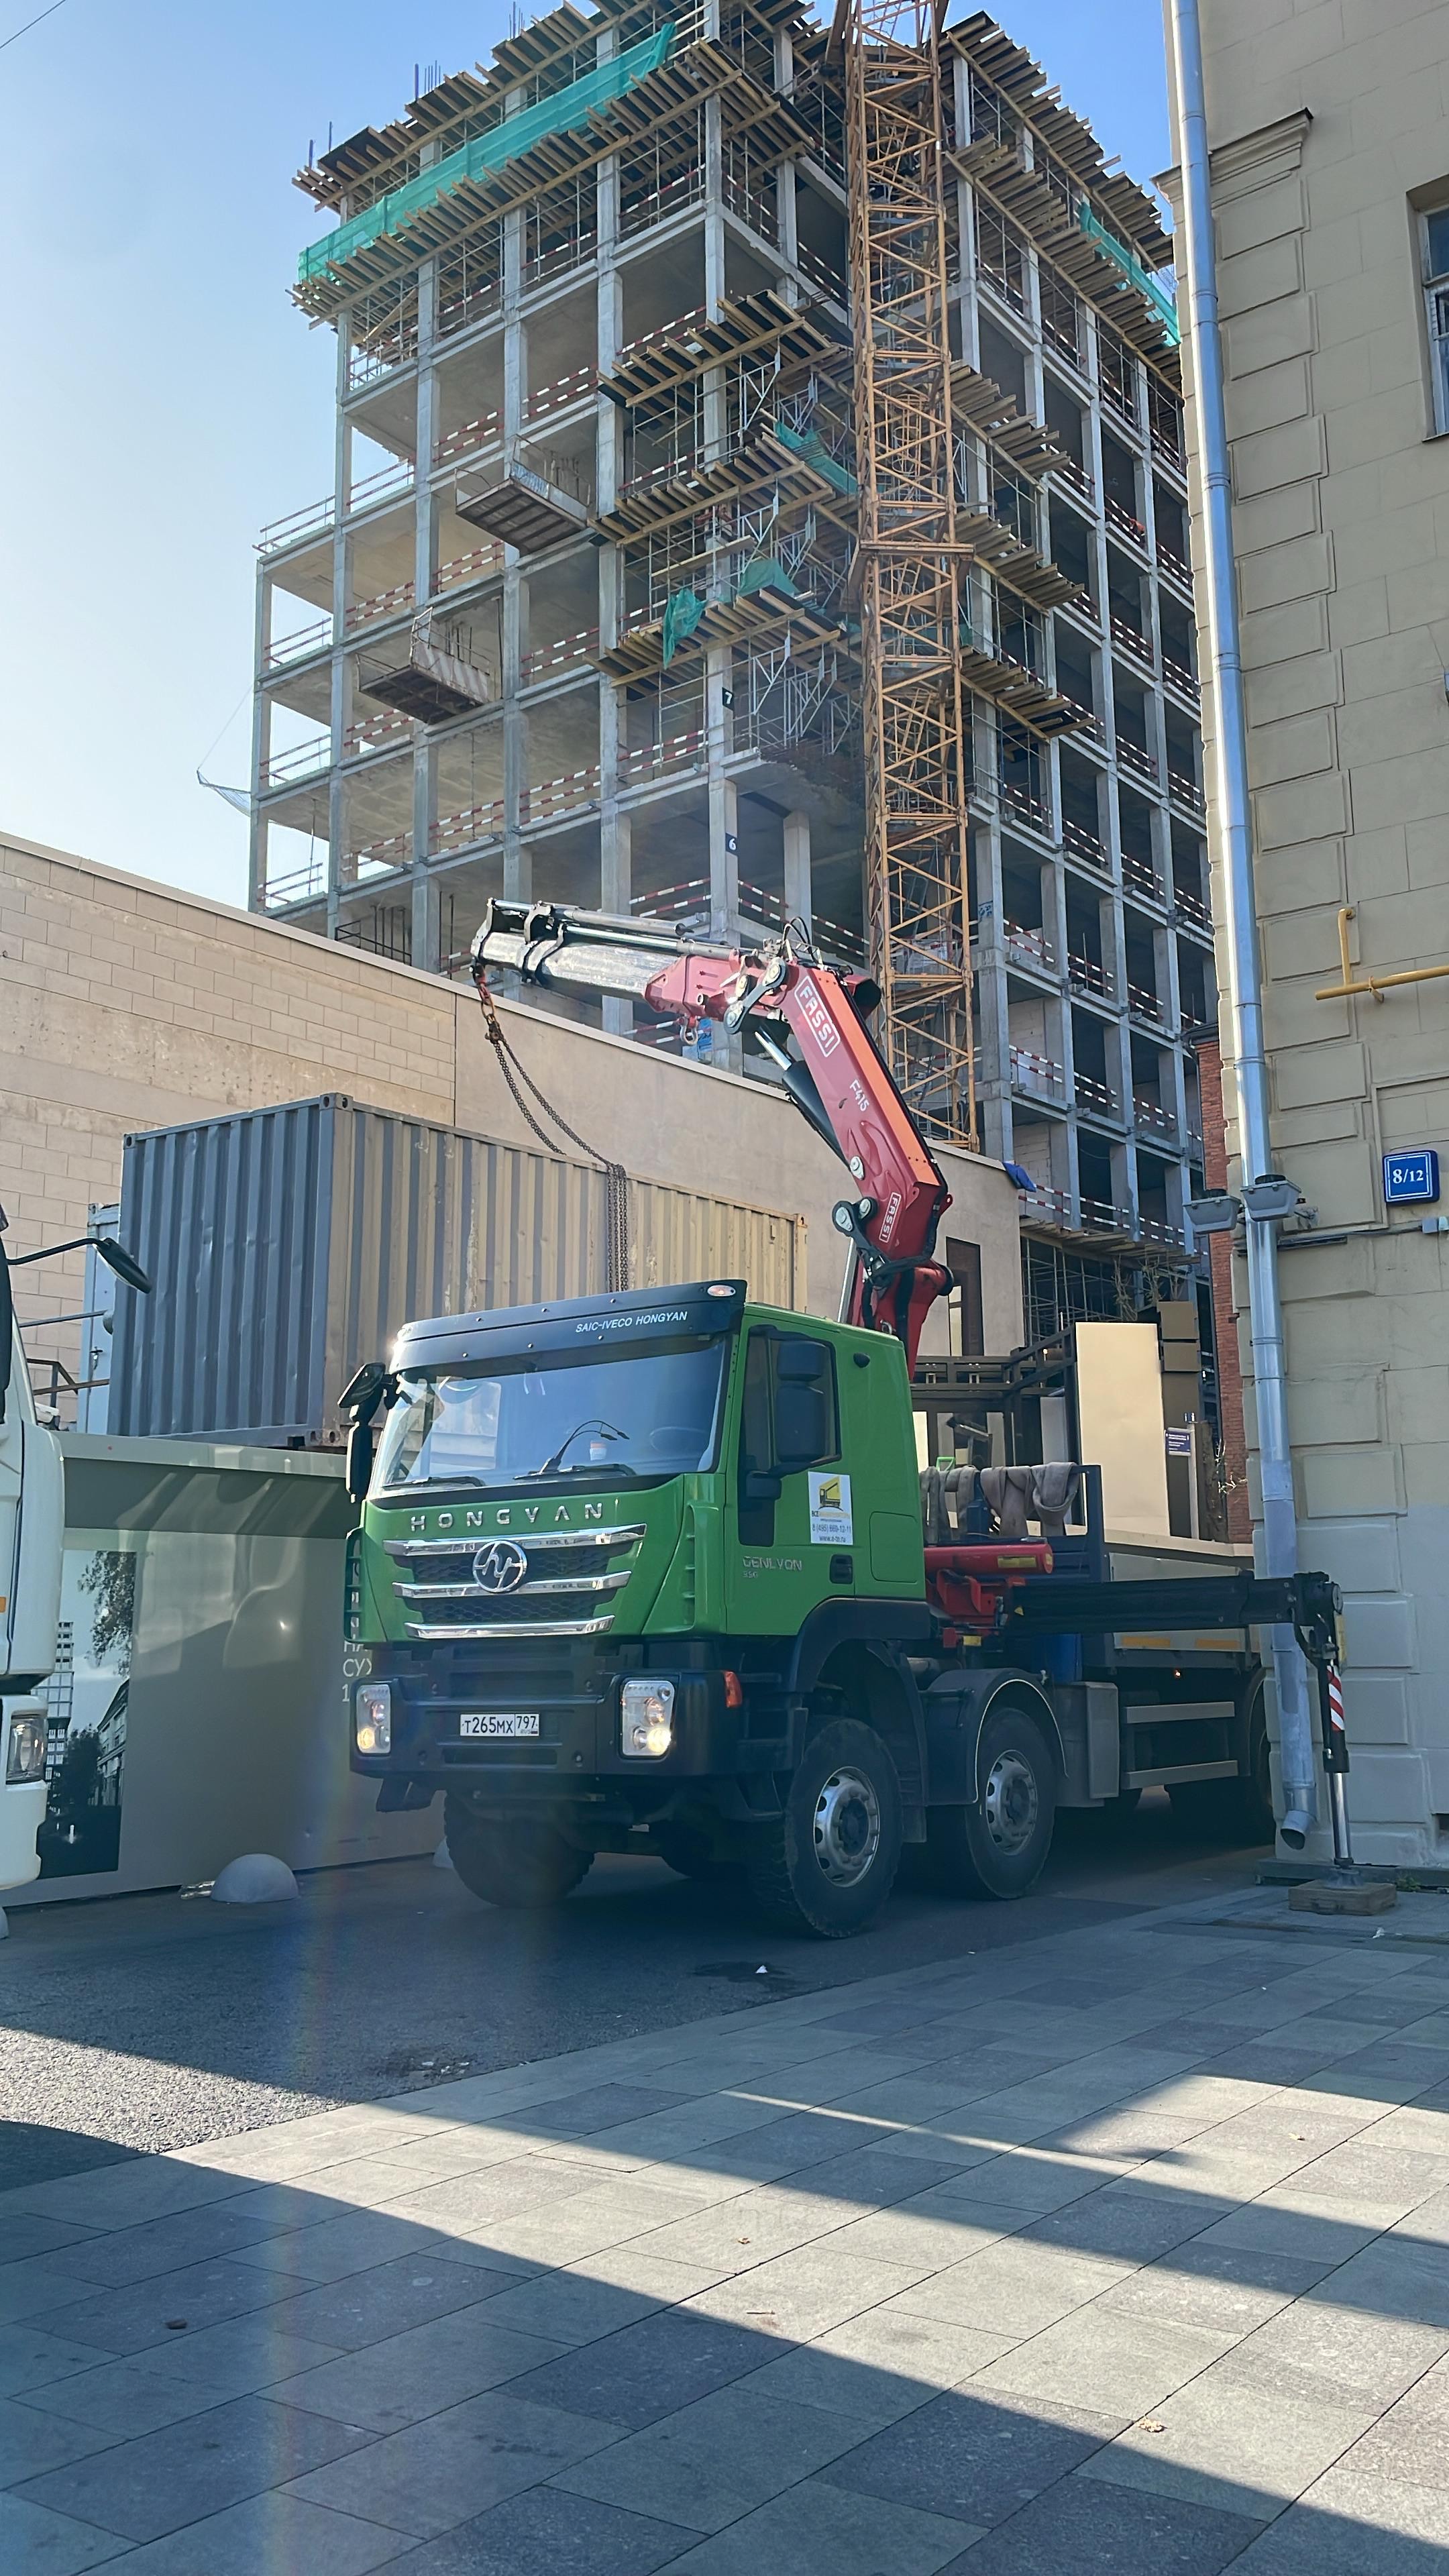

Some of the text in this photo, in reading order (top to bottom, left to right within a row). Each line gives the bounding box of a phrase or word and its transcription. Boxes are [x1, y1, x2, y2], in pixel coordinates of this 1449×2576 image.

[724, 692, 733, 704] 7
[729, 838, 737, 851] 6
[800, 985, 835, 1048] FASSI
[849, 1079, 869, 1112] F415
[1392, 1169, 1424, 1184] 8/12
[881, 1197, 898, 1238] FASSI
[575, 1311, 688, 1333] SAIC-IVECO HONGYAN
[410, 1502, 603, 1532] HONGYAN
[743, 1556, 802, 1571] GENLYON
[464, 1715, 536, 1733] Т265МХ 797
